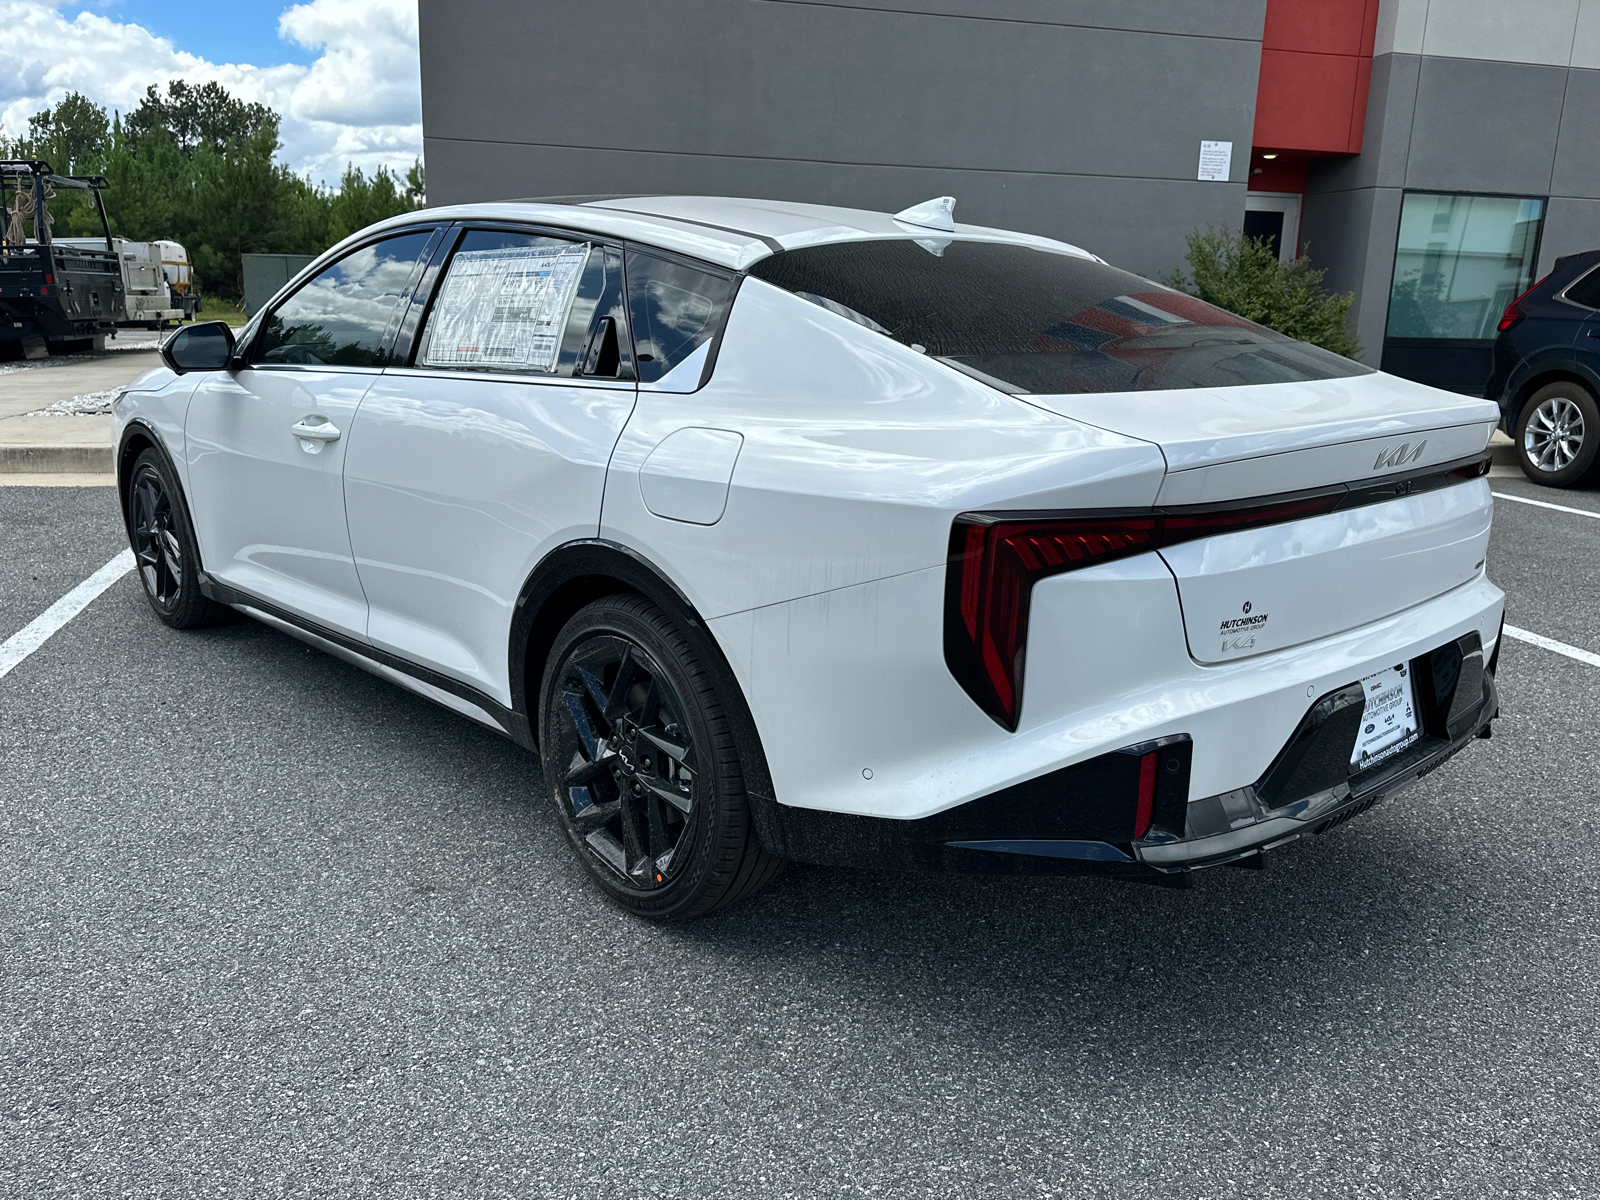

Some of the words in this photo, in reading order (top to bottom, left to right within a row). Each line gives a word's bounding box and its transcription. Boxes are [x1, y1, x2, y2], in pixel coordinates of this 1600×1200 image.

[1373, 439, 1428, 470] KIA
[1220, 614, 1268, 629] HUTCHINSON
[1220, 627, 1249, 635] AUTOMOTIVE
[1222, 633, 1255, 652] K4
[1365, 684, 1404, 713] UTCHINSON
[1389, 698, 1402, 711] GROUP
